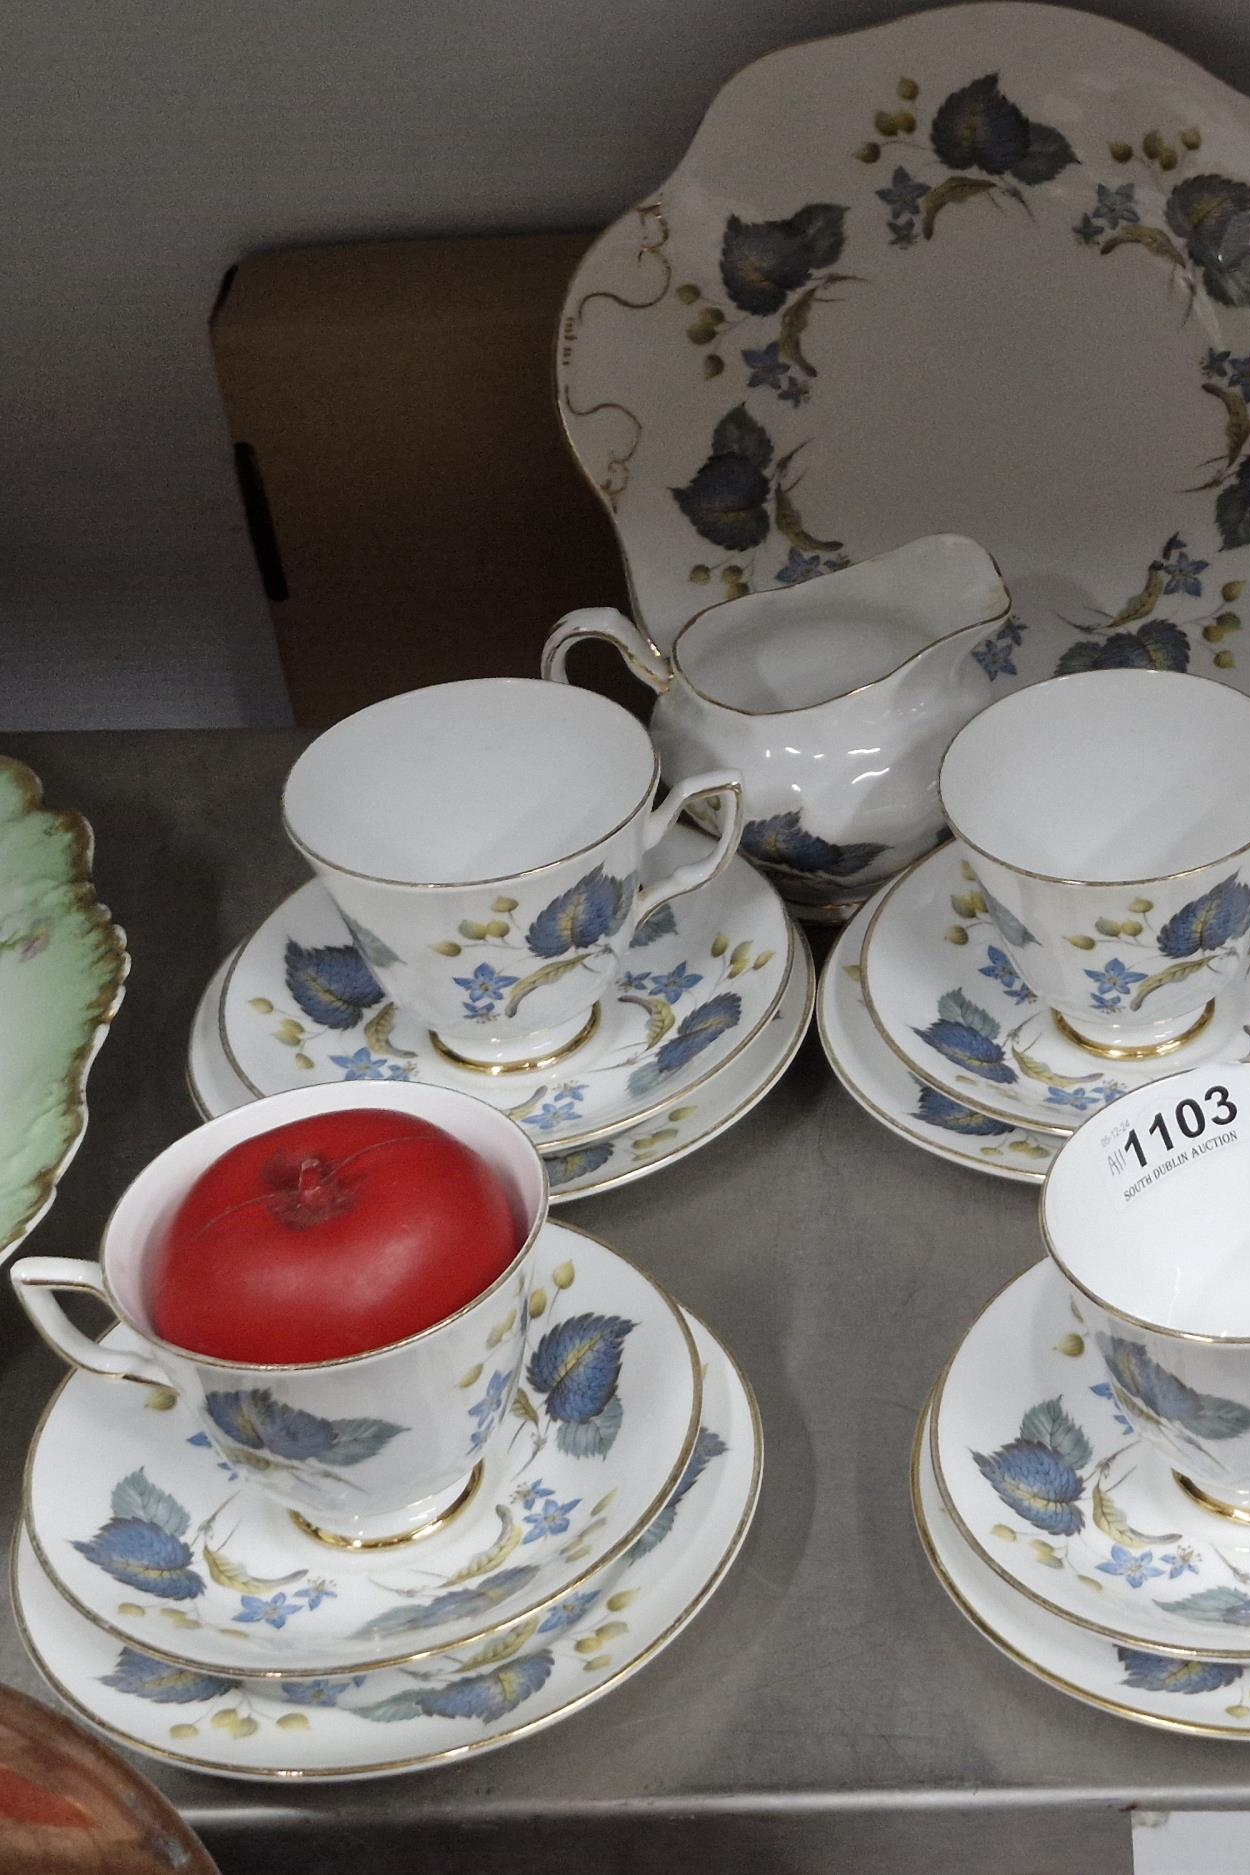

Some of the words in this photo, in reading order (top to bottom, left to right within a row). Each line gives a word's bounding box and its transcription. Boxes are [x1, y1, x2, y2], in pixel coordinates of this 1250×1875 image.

[1124, 1085, 1238, 1168] 1103
[1123, 1174, 1152, 1202] SOUTH
[1152, 1151, 1189, 1181] DUBLIN
[1191, 1130, 1238, 1158] AUCTION
